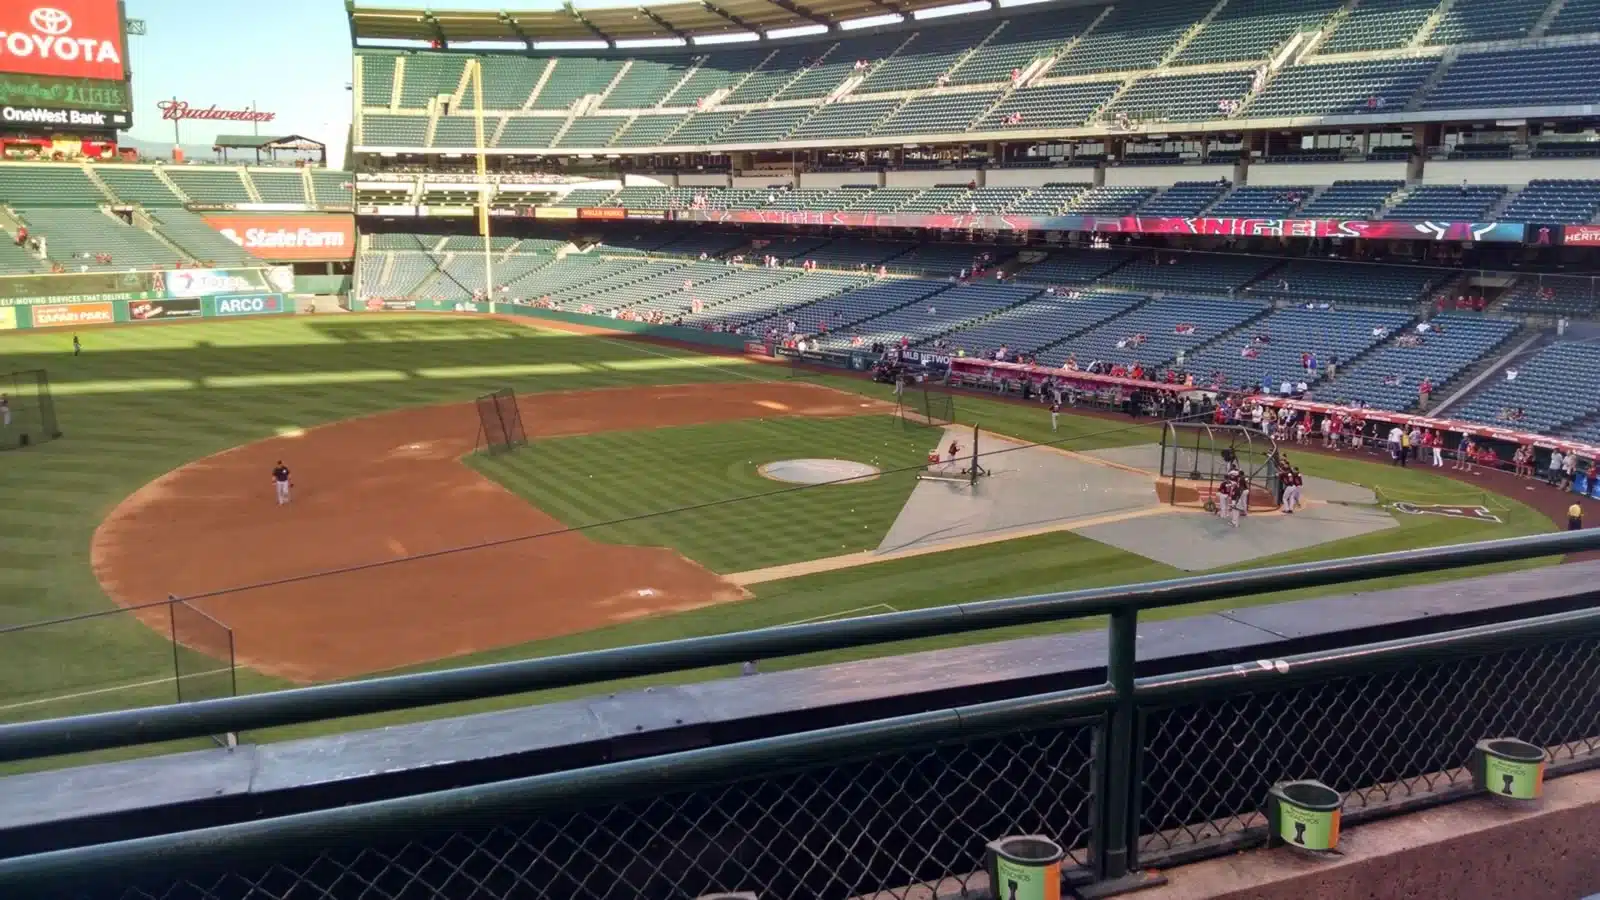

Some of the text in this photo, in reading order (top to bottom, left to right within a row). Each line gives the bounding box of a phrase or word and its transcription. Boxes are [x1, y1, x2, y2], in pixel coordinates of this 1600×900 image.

[2, 106, 68, 123] OneWest
[69, 110, 104, 125] Bank
[157, 100, 275, 121] Budweiser
[1564, 232, 1600, 243] HERIT
[48, 294, 81, 304] SERVICES
[83, 293, 101, 302] THAT
[218, 298, 264, 313] ARCO
[902, 350, 919, 361] MLB
